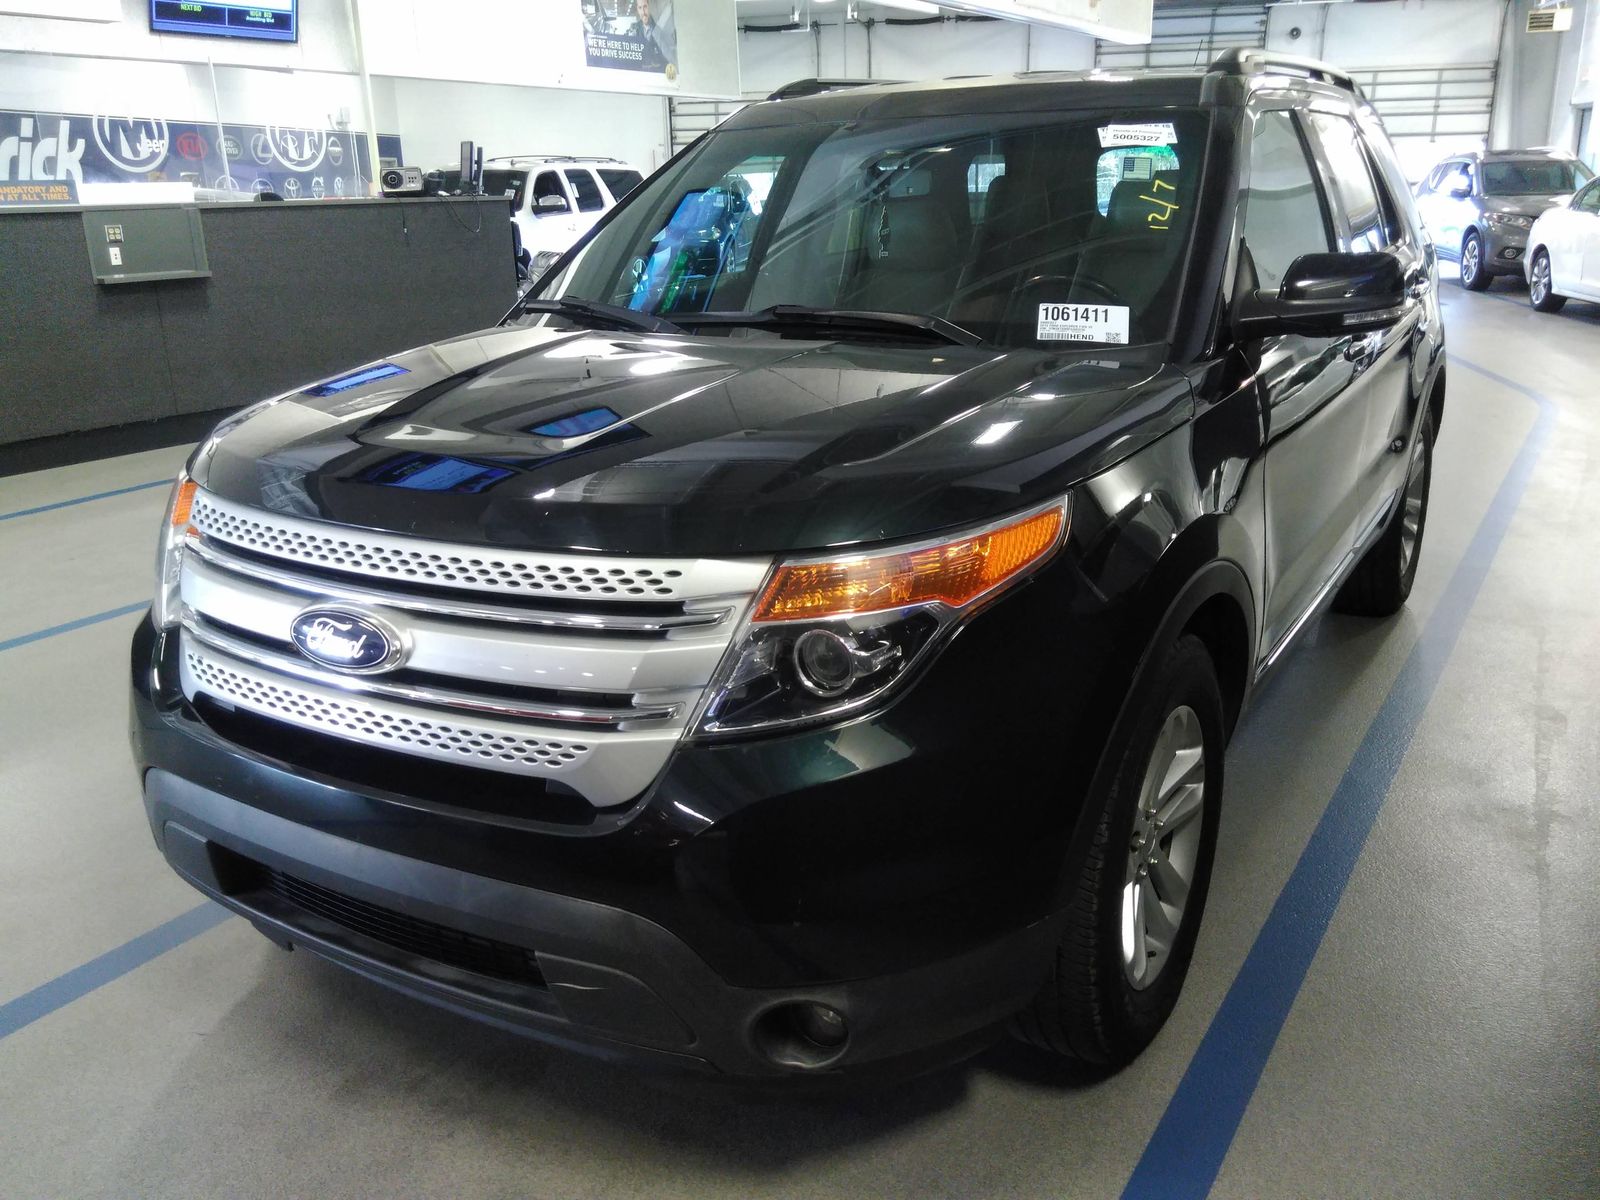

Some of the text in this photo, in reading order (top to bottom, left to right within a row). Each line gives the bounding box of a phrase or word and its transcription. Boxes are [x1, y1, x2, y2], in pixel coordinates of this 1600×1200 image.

[588, 39, 644, 51] WE'RE HERE TO HELP
[589, 47, 642, 60] YOU DRIVE SUCCESS
[1112, 133, 1160, 142] 5005327
[49, 185, 69, 194] AND
[22, 193, 39, 201] ALL
[1042, 307, 1108, 323] 1061411
[302, 617, 367, 659] Ford
